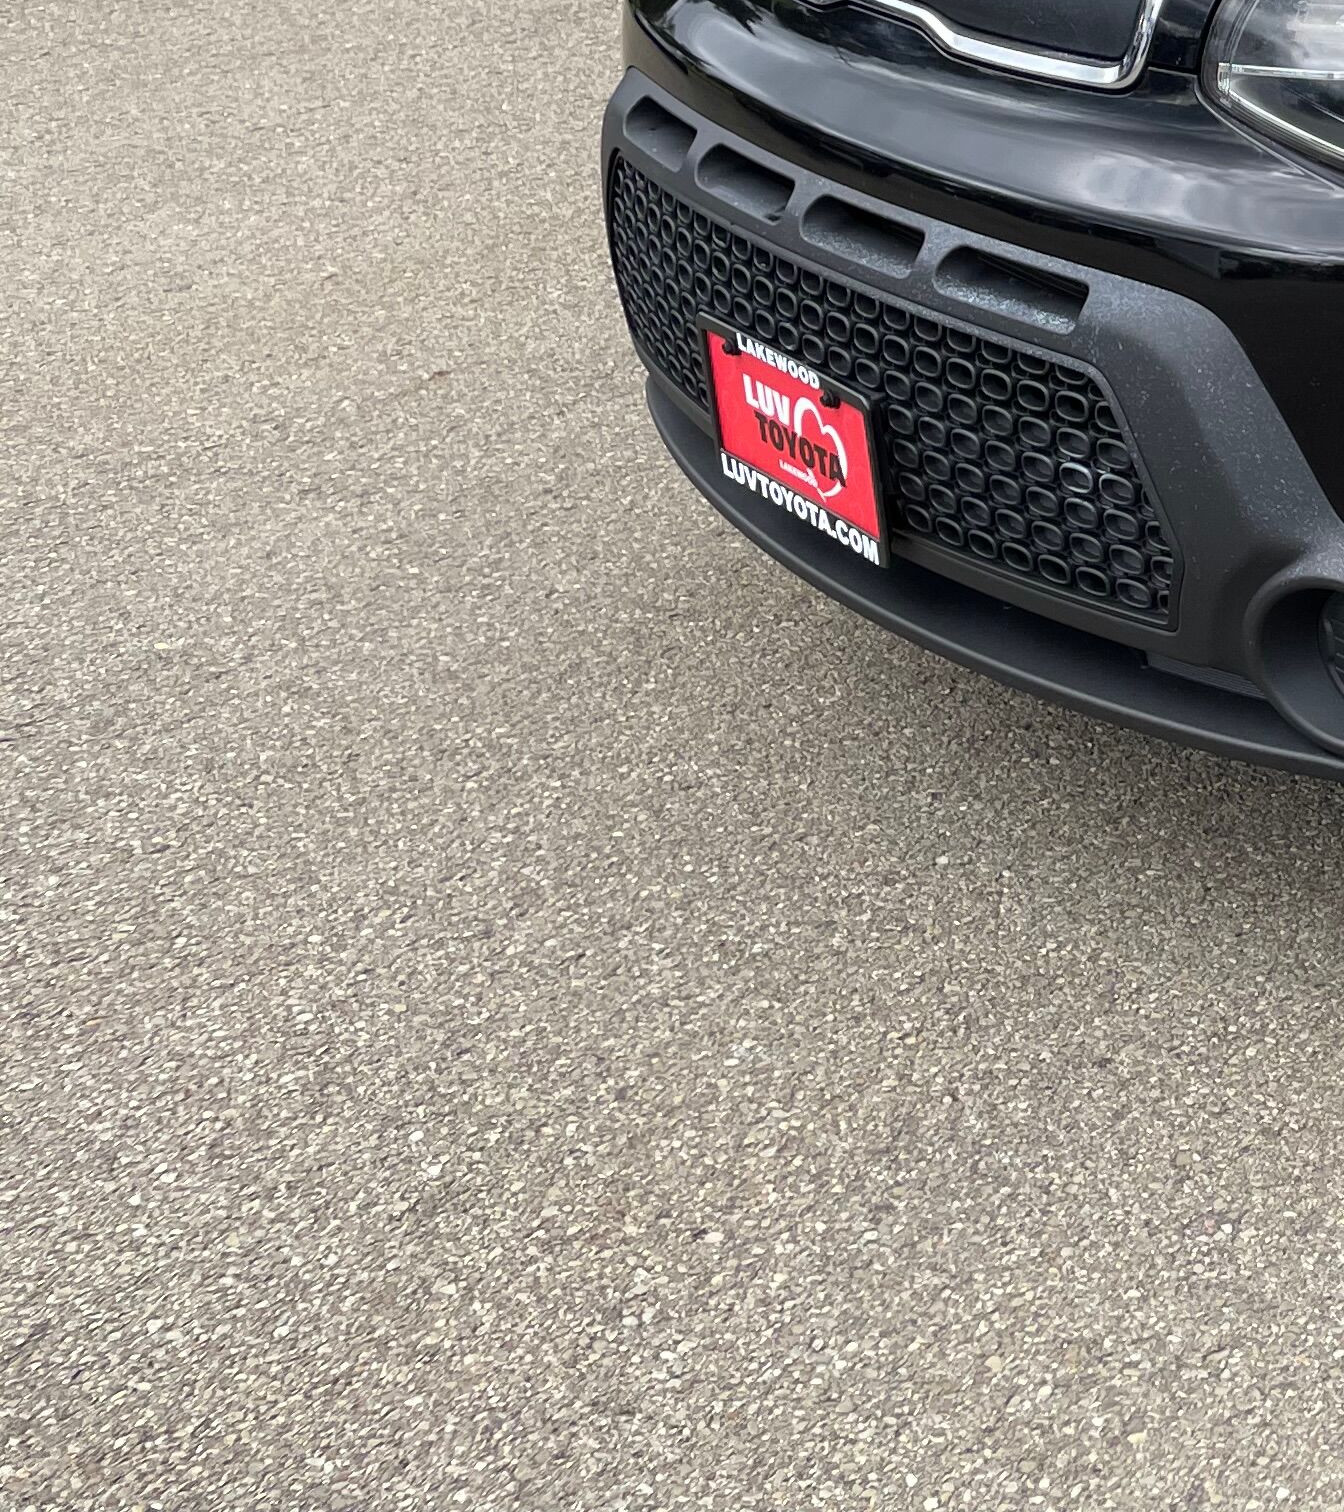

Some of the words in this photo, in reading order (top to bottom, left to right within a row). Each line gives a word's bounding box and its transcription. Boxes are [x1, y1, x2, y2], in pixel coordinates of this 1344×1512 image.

[736, 332, 820, 389] LAKEWOOD
[742, 373, 791, 426] LUV
[754, 410, 847, 488] TOYOTA
[720, 453, 881, 565] LUVTOYOTA.COM
